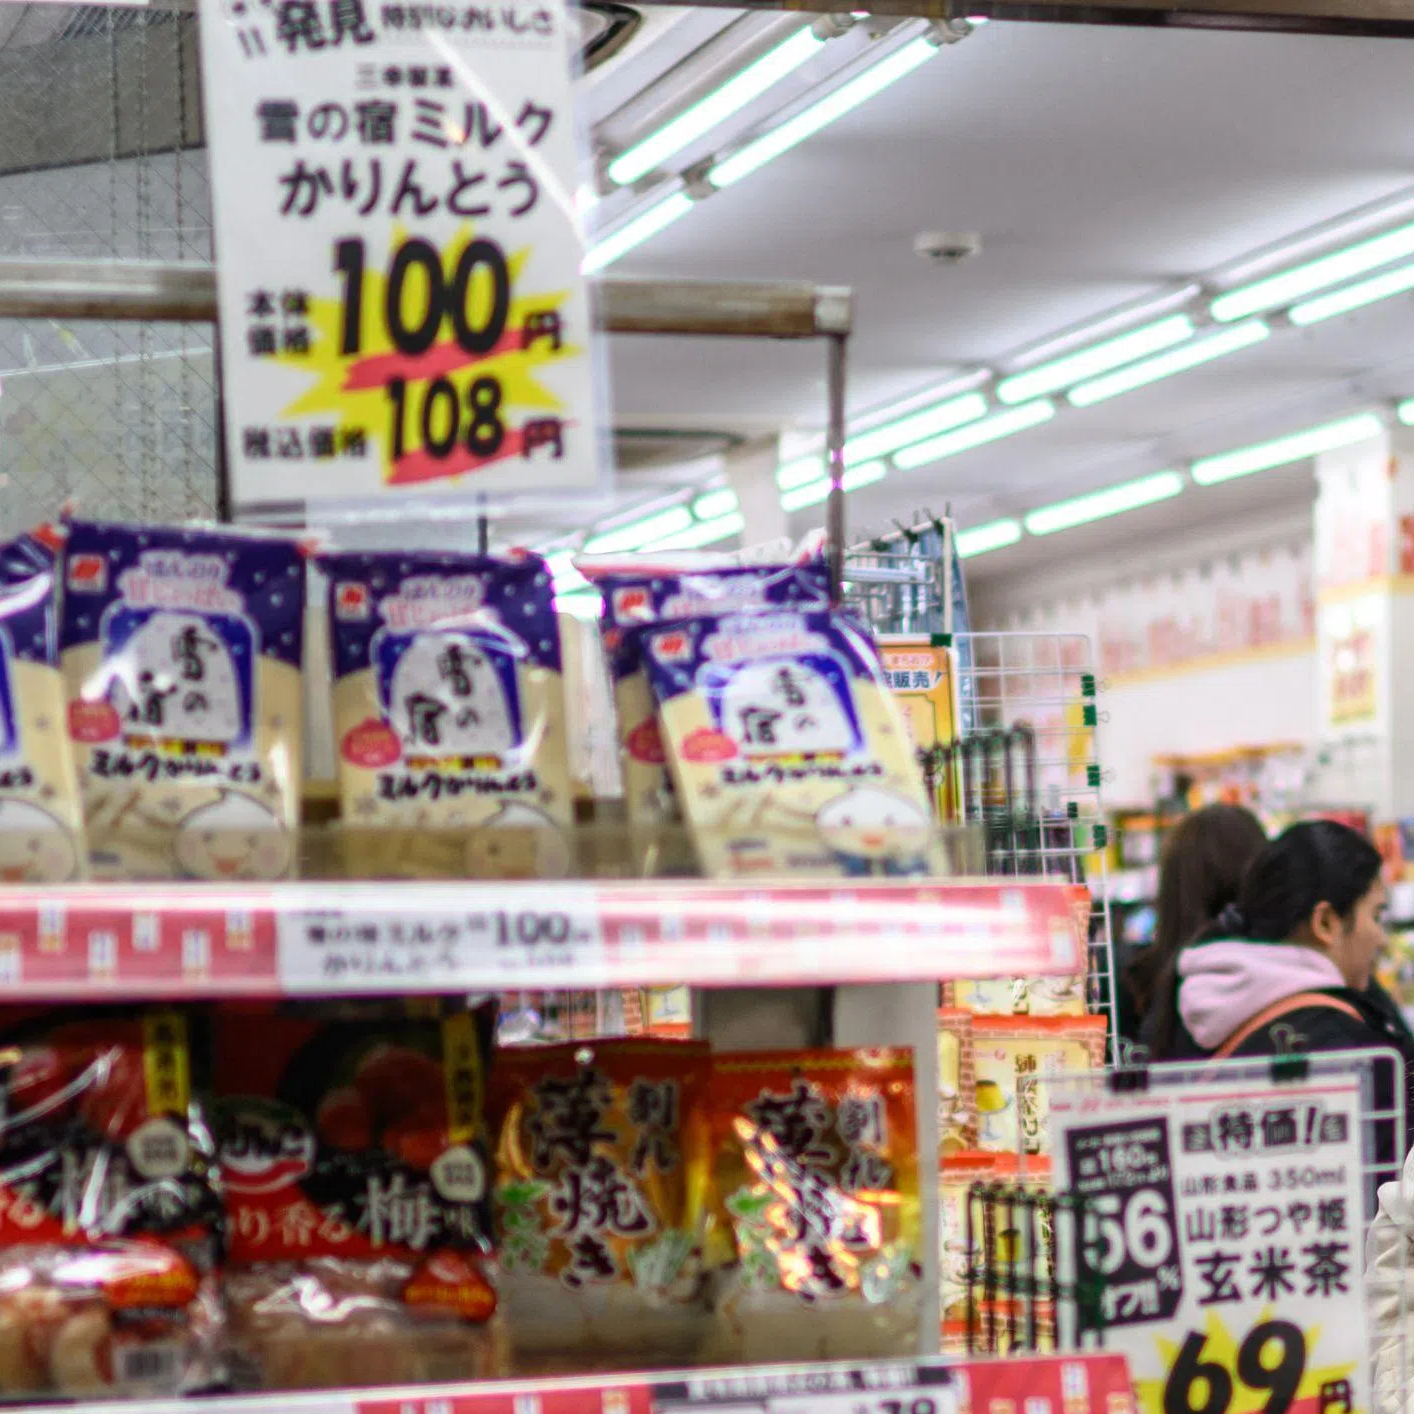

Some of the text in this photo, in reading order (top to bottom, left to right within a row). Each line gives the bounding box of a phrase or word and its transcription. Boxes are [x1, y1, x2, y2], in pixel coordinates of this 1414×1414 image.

[256, 99, 553, 148] 雪の宿ミルク
[280, 160, 540, 217] かりんとう
[1186, 1200, 1349, 1245] 山形つや姫
[1195, 1242, 1350, 1306] 玄米茶
